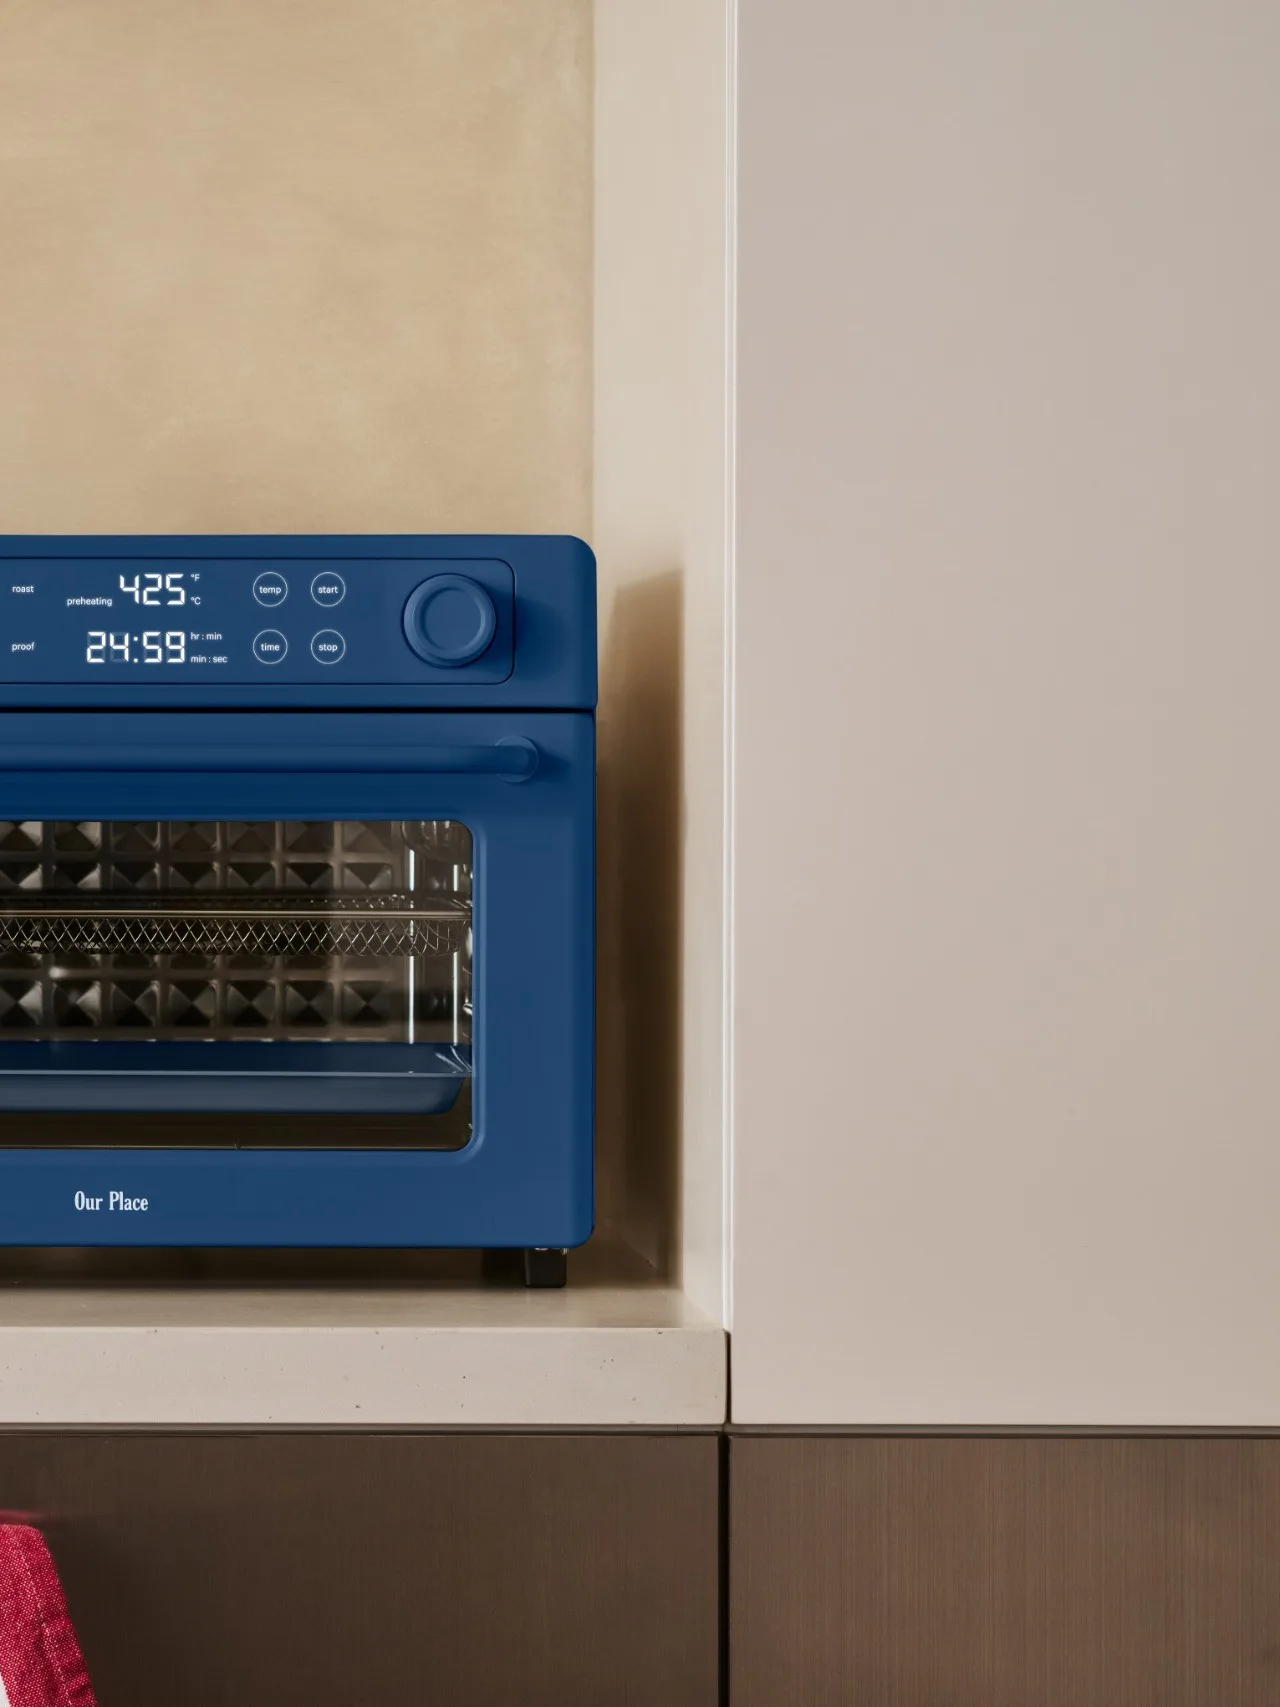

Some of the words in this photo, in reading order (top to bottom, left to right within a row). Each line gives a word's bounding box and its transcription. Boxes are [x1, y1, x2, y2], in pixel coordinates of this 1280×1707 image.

[11, 584, 34, 593] roast
[119, 572, 186, 606] 425
[258, 585, 282, 595] temp
[317, 585, 339, 594] start
[66, 596, 113, 608] preheating
[11, 641, 35, 653] proof
[86, 631, 186, 664] 24:59
[260, 642, 280, 652] time
[317, 643, 339, 653] stop
[74, 1190, 104, 1211] Our
[108, 1190, 149, 1211] Place
